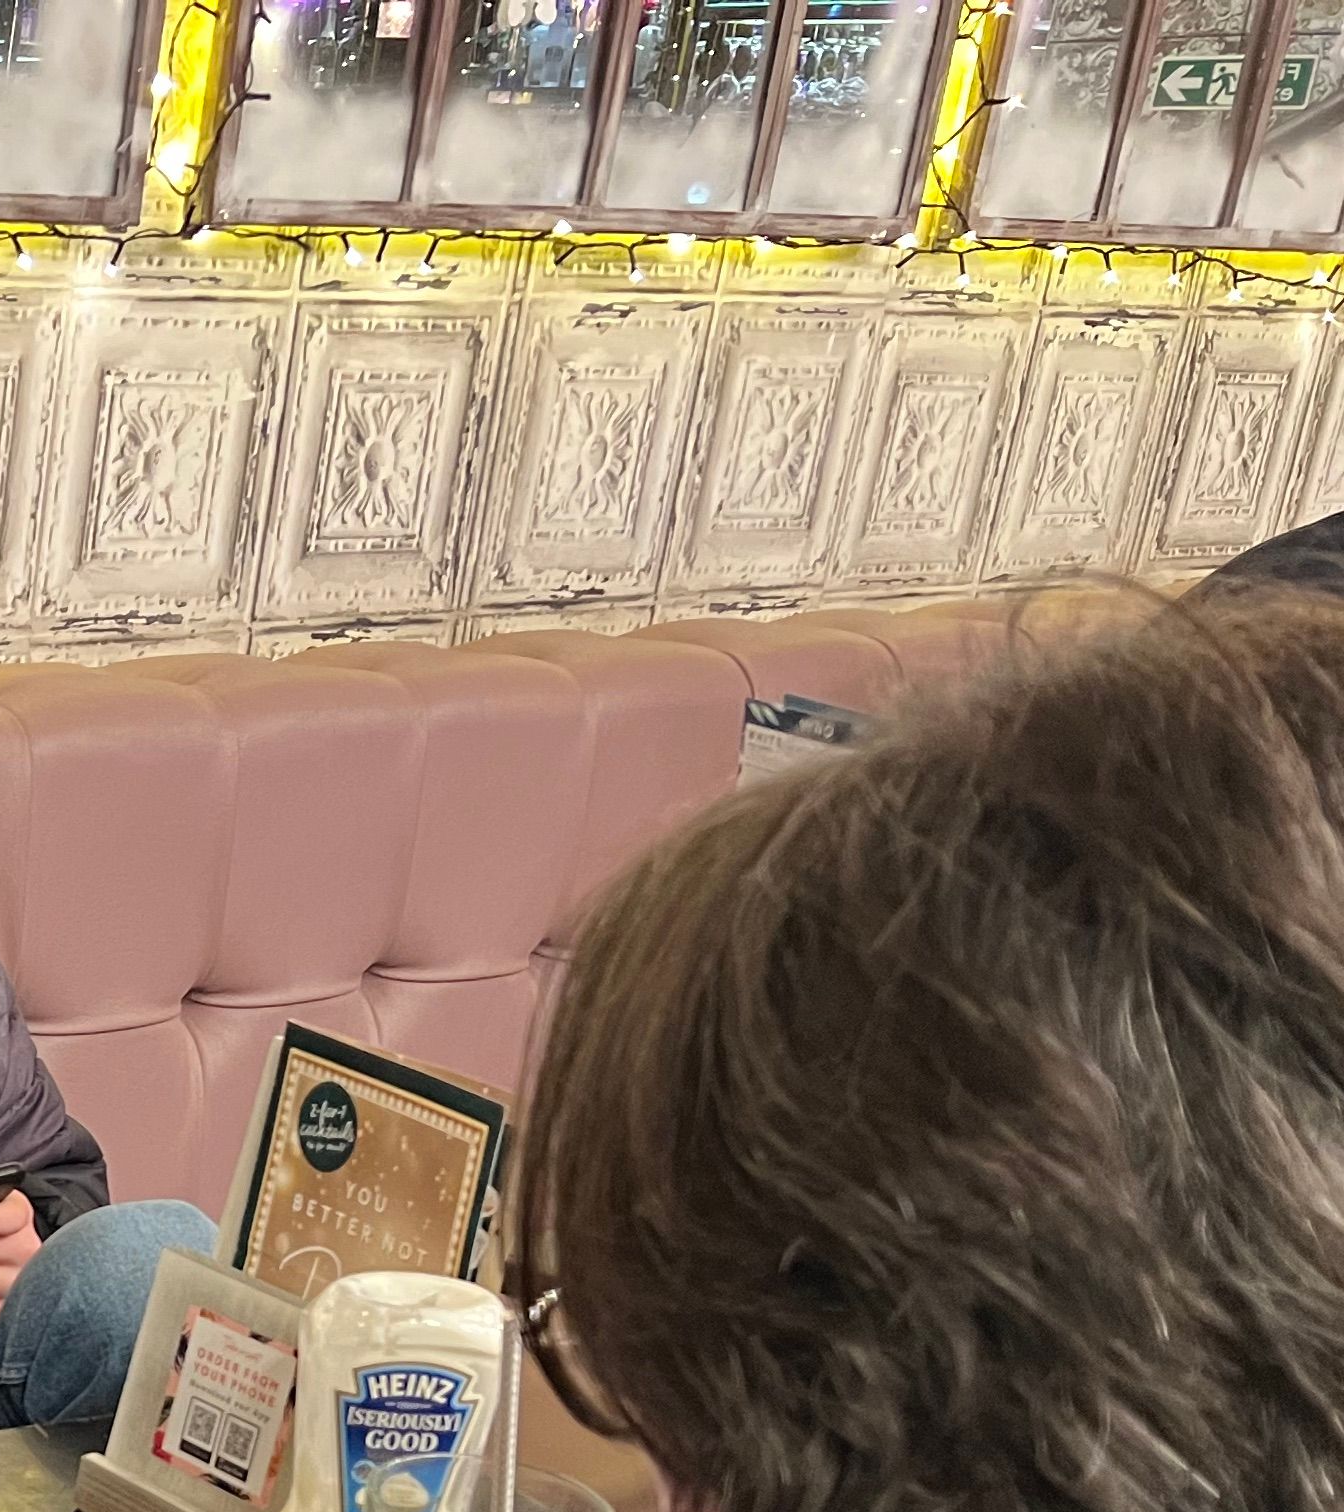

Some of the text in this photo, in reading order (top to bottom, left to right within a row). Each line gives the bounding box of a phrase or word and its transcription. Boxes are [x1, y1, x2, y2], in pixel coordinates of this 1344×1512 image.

[346, 1180, 388, 1213] YOU
[292, 1193, 428, 1267] BETTER NOT
[194, 1361, 277, 1408] YOUR PHONE
[197, 1347, 239, 1374] ORDER
[243, 1368, 280, 1390] FROM
[367, 1373, 456, 1404] HEINZ
[365, 1429, 440, 1453] GOOD
